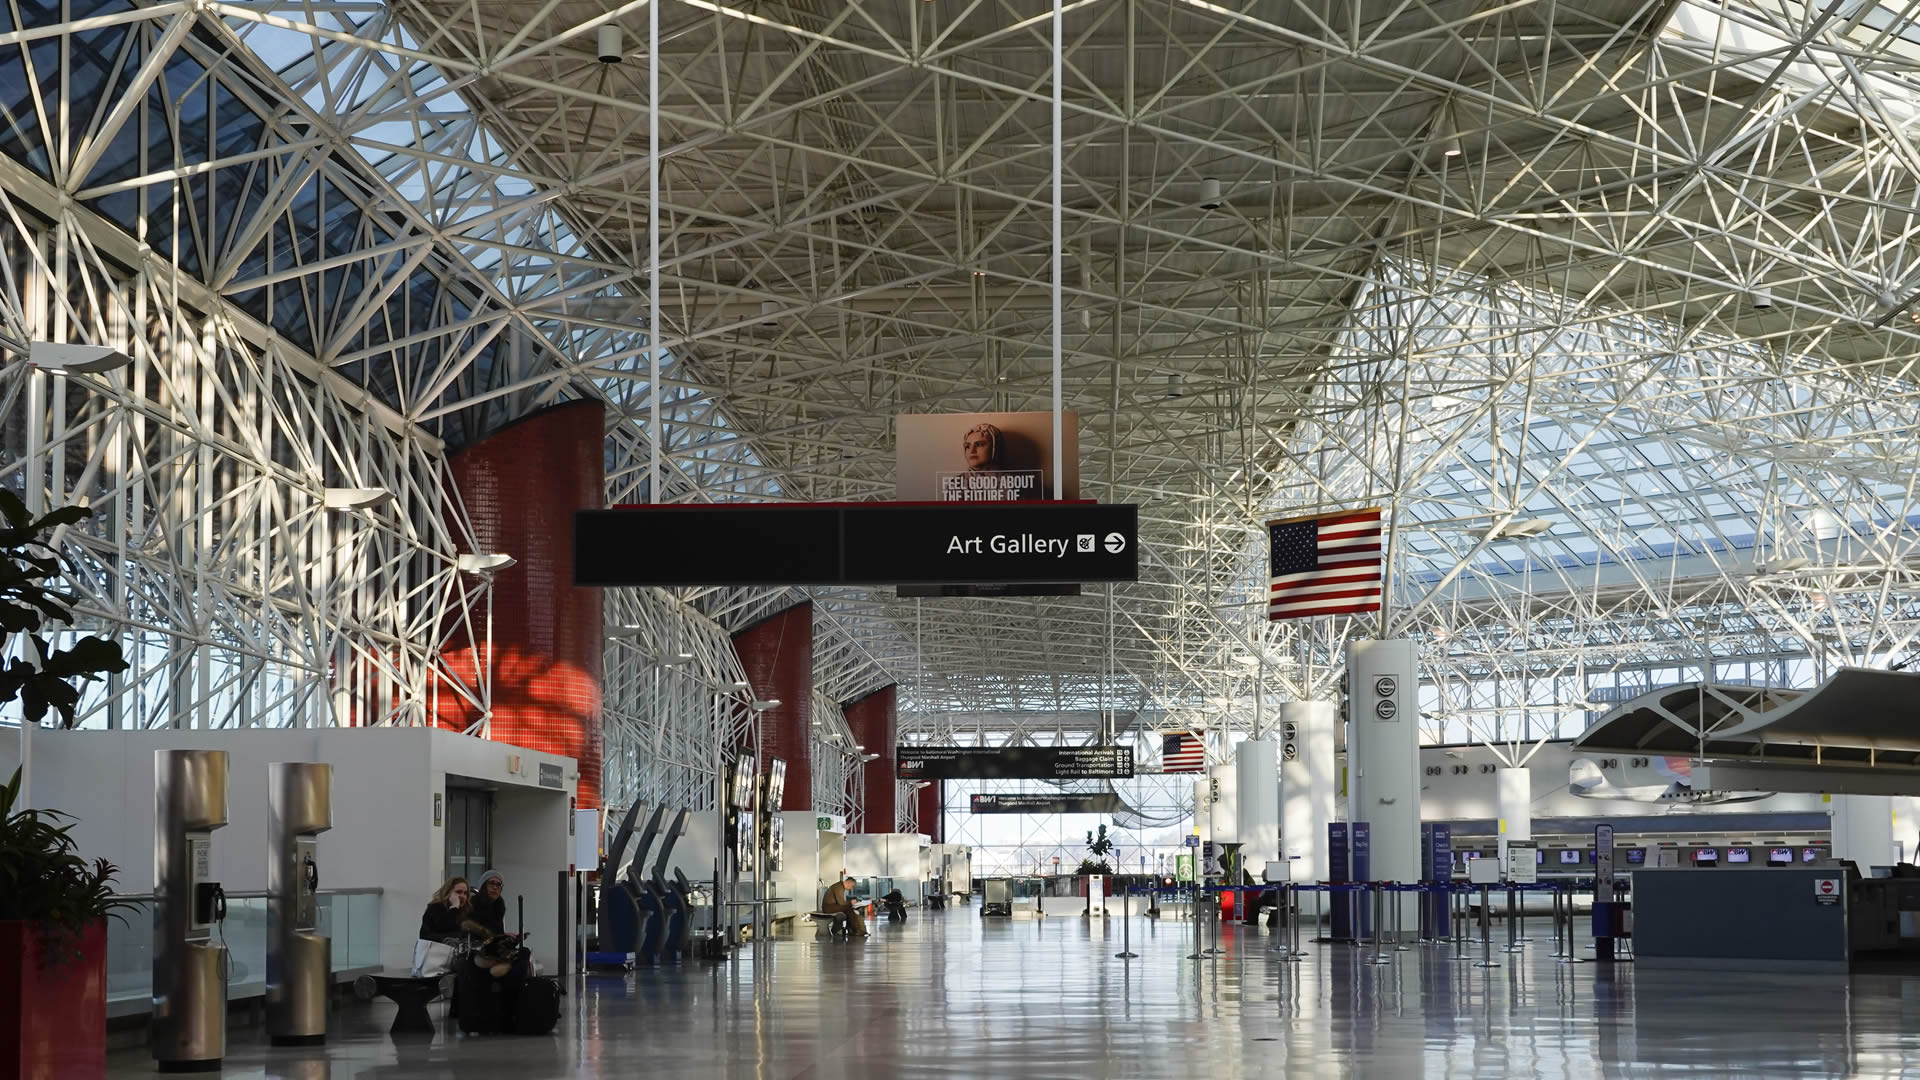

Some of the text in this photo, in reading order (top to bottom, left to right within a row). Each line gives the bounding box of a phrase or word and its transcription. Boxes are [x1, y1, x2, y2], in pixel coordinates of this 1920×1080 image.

[942, 475, 1035, 490] FEEL GOOD ABOUT
[942, 489, 1020, 501] THE FUTURE OF
[947, 533, 1069, 558] Art Gallery
[907, 761, 924, 769] BWI
[980, 795, 996, 803] BWI
